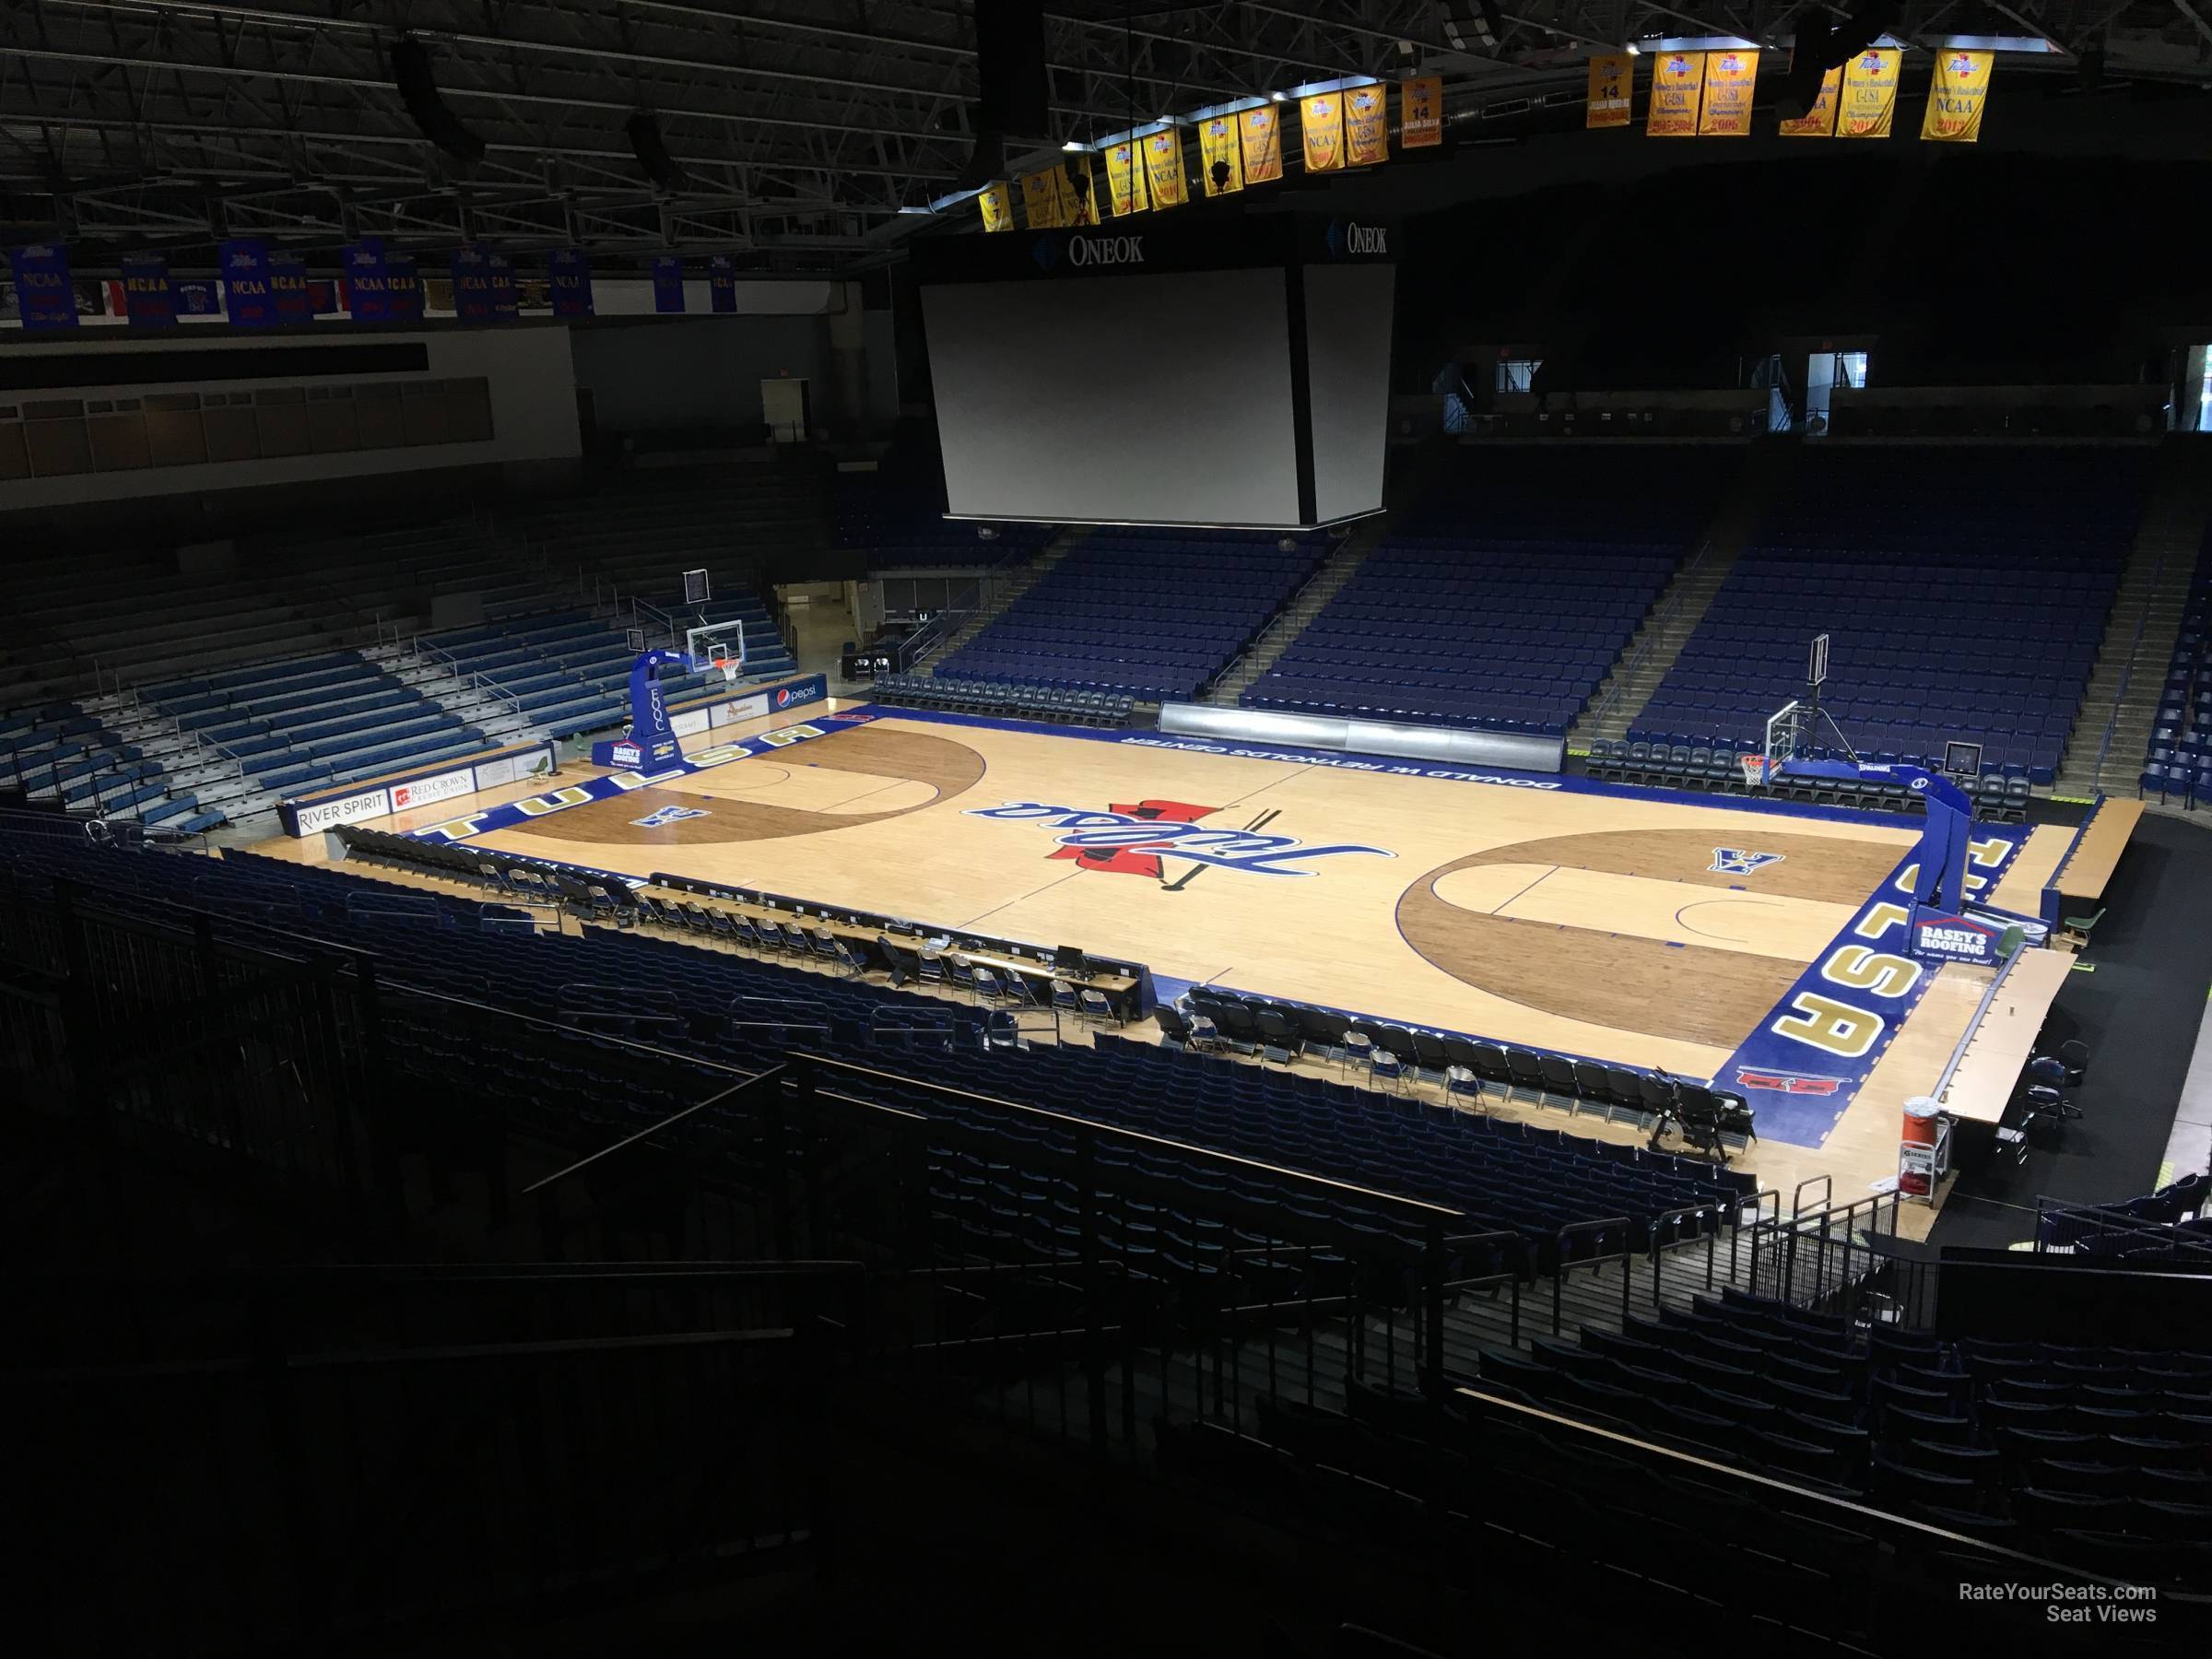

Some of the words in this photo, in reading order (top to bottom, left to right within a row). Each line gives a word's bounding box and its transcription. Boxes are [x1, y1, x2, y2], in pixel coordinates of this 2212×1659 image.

[1413, 107, 1430, 120] 14
[1936, 99, 1972, 113] NCAA
[1310, 135, 1335, 147] NCAA
[1155, 168, 1177, 182] NCAA
[22, 272, 62, 288] NCAA
[126, 276, 169, 292] NCAA
[231, 279, 266, 295] NCAA
[354, 276, 384, 291] NCAA
[791, 684, 817, 702] pepsi
[1121, 737, 1228, 753] CENTER
[1230, 749, 1384, 771] REYNOLDS
[1858, 764, 1890, 773] SPALDING
[1427, 771, 1563, 790] DONALD
[299, 806, 340, 830] RIVER
[344, 794, 382, 815] SPIRIT
[1922, 925, 1987, 946] BASEY'S
[1921, 937, 1986, 956] ROOFING
